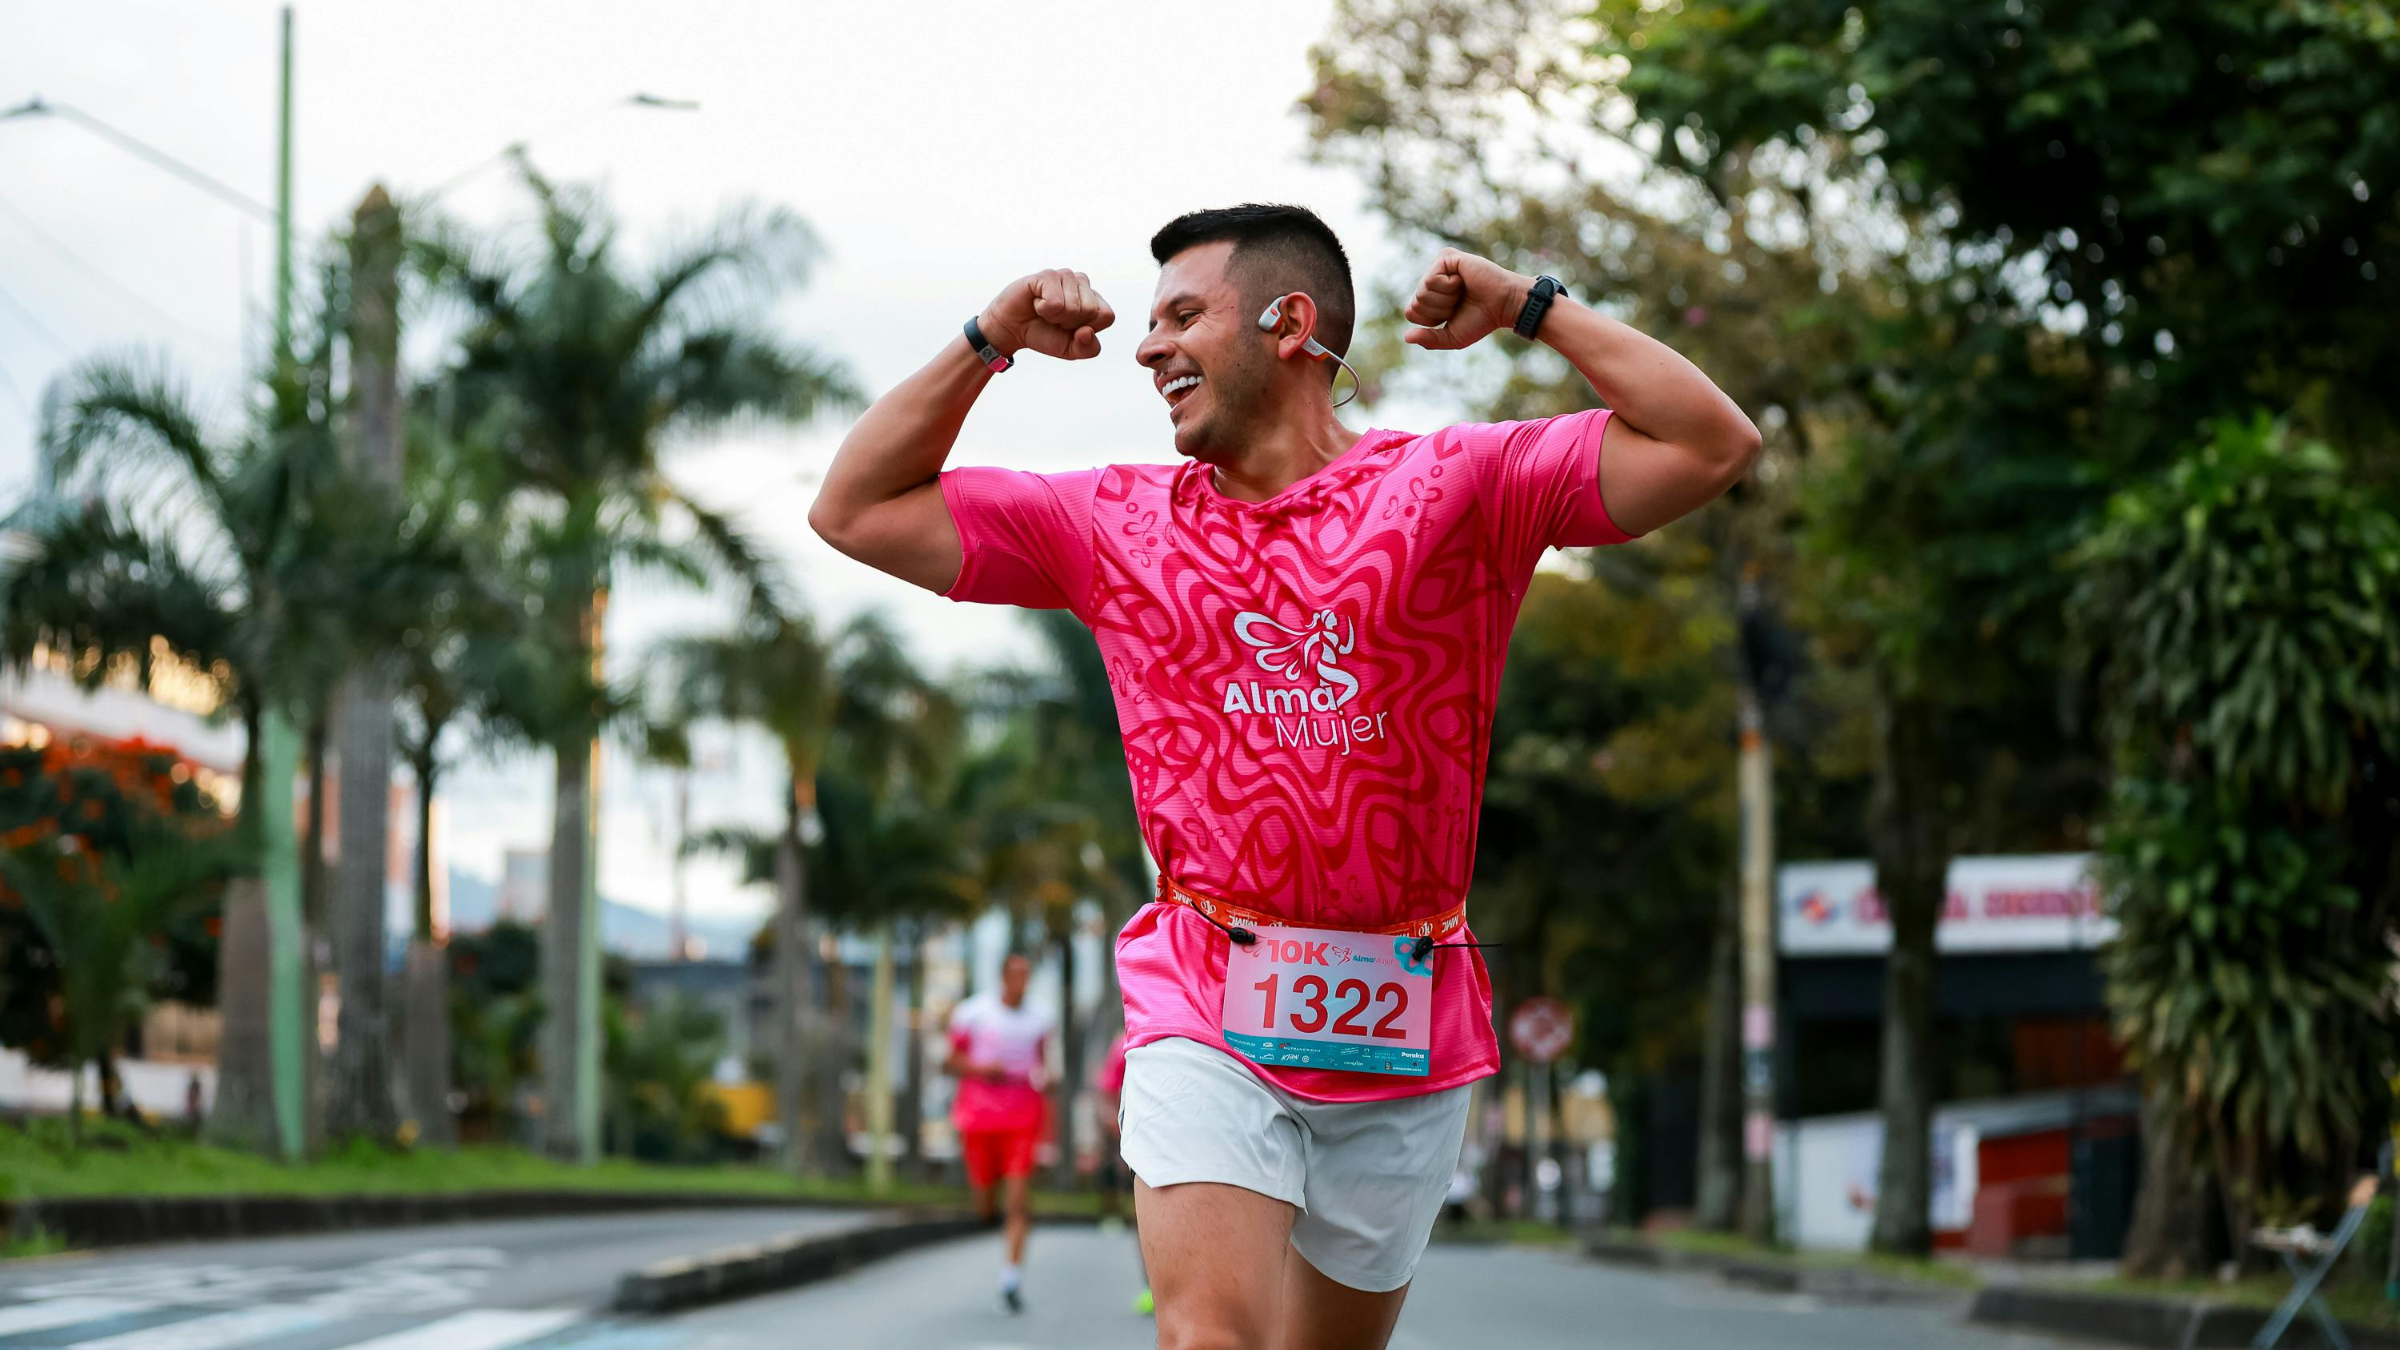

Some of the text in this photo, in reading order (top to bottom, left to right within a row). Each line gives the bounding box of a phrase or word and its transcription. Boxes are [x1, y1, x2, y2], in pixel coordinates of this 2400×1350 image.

[1223, 682, 1338, 714] Alma
[1275, 710, 1388, 755] Mujer
[1267, 939, 1330, 966] 10K
[1254, 973, 1409, 1040] 1322
